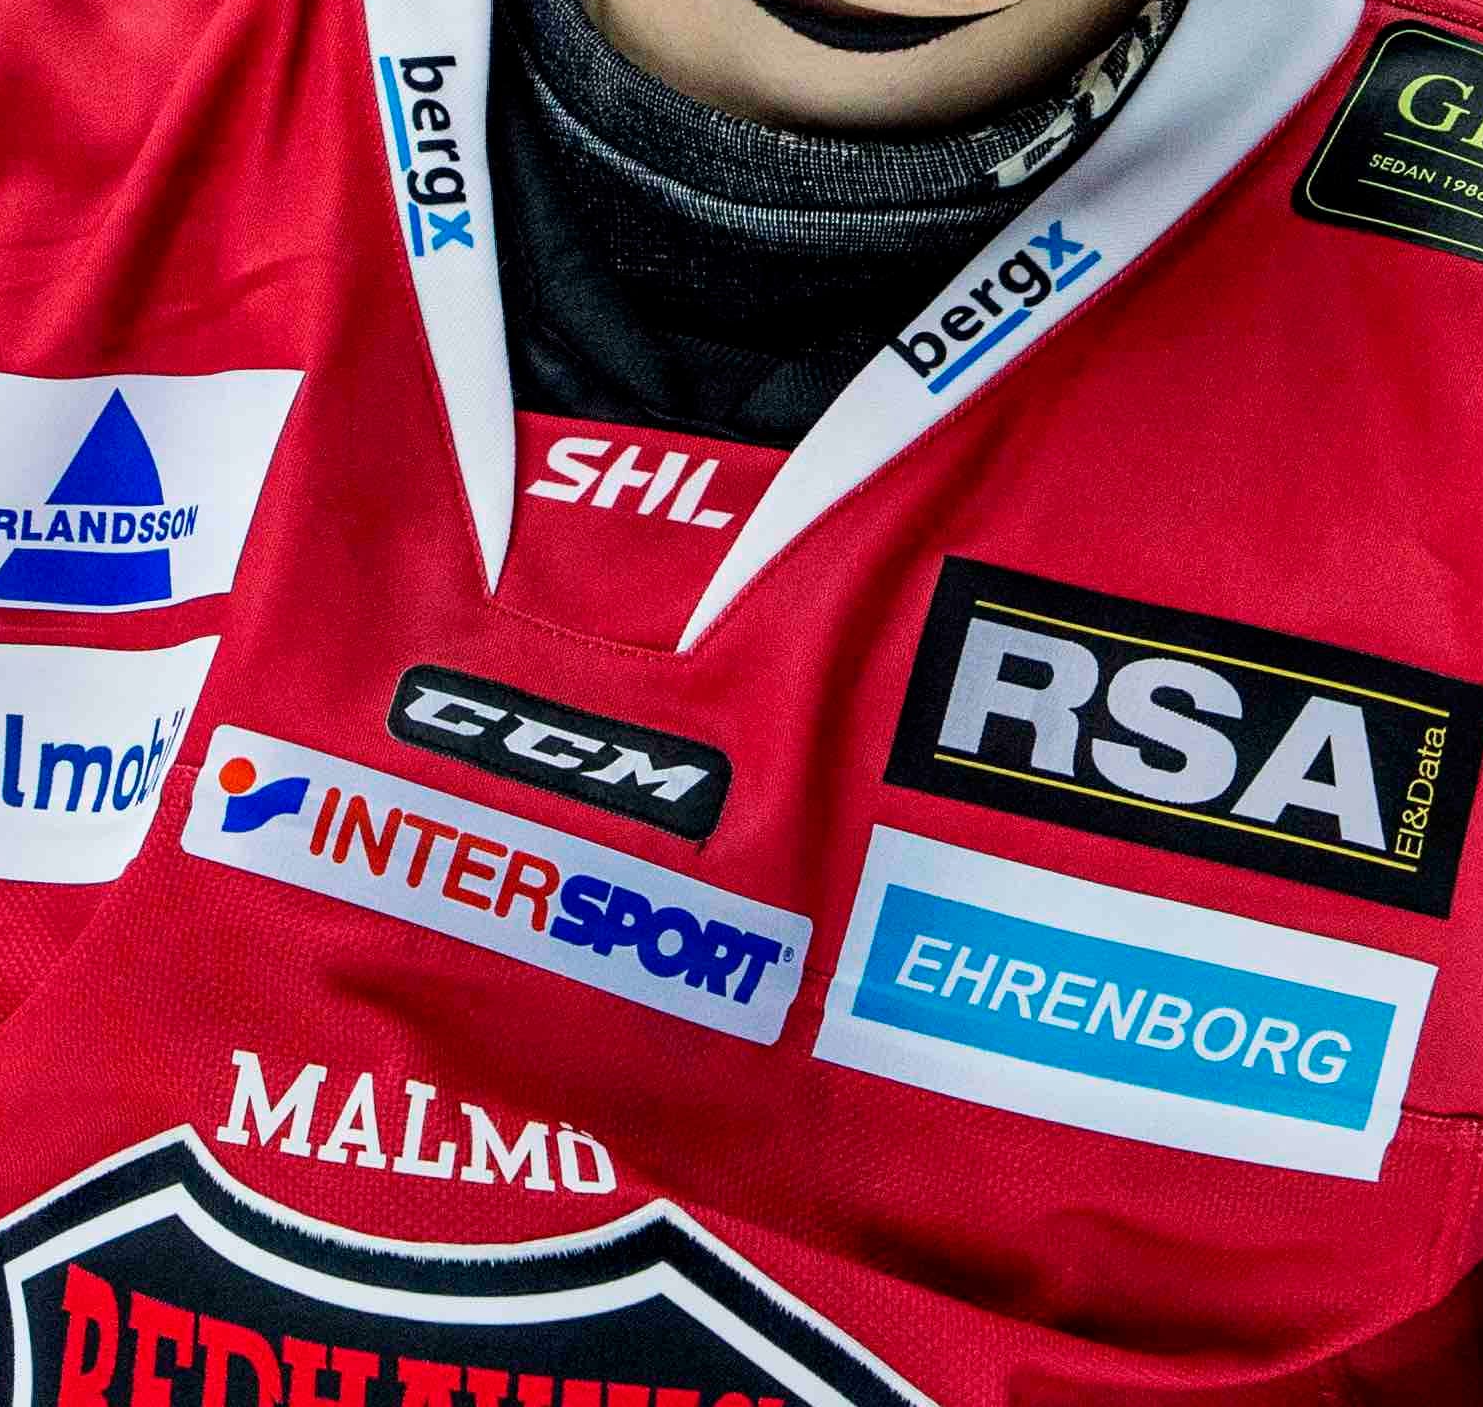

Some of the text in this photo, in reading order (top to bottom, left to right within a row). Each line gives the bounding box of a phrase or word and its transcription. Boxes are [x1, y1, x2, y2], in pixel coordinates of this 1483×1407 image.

[399, 54, 475, 251] bergx
[1368, 153, 1438, 185] SEDAN
[886, 218, 1085, 380] bergx
[524, 436, 741, 529] SHL
[404, 685, 711, 803] CCM
[936, 616, 1387, 853] RSA
[309, 785, 784, 1006] INTERSPORT
[894, 933, 1353, 1085] EHRENBORG
[216, 1048, 618, 1195] MALMÖ
